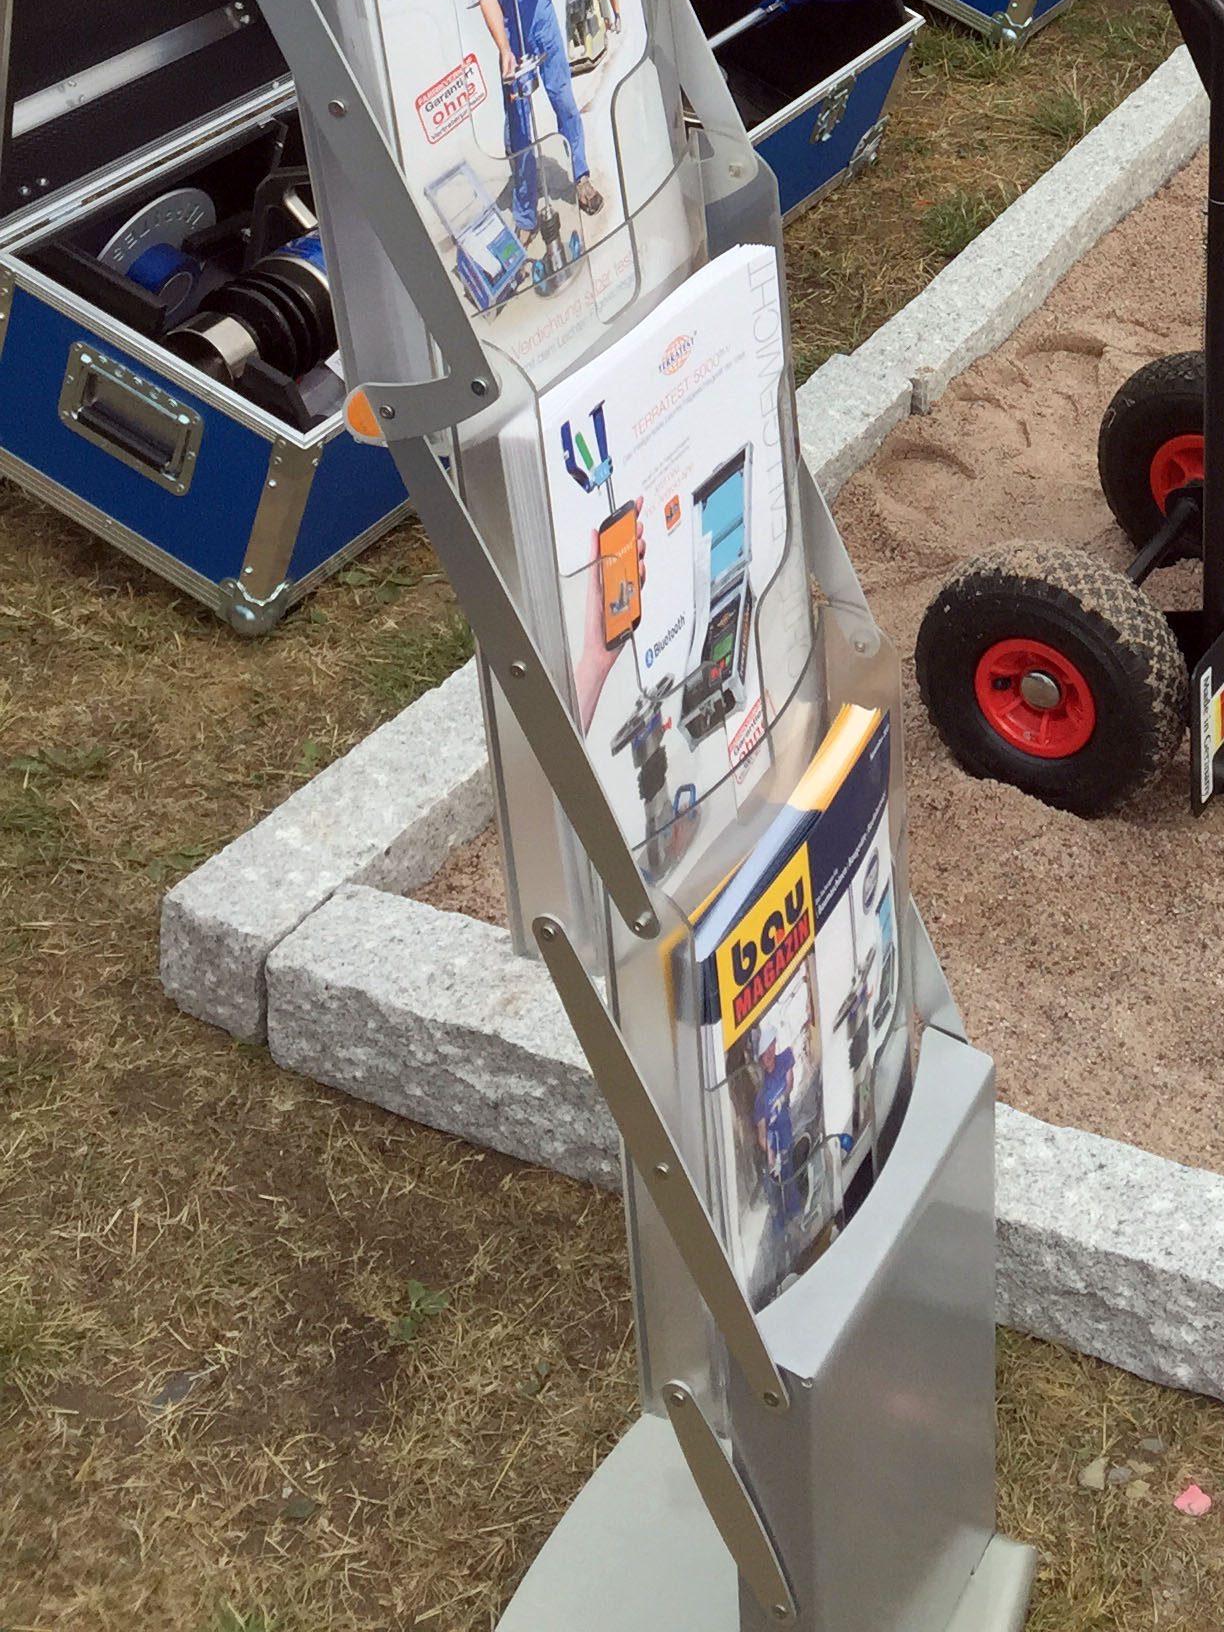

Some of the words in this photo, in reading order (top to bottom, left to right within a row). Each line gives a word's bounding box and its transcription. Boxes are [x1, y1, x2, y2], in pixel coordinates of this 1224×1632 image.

[658, 337, 695, 373] TERRATEST
[632, 378, 691, 439] TERRATEST
[653, 611, 687, 658] Bluetooth
[1203, 677, 1211, 714] Made
[1203, 735, 1212, 797] Germany
[731, 877, 804, 987] bau
[734, 911, 810, 1025] MAGAZIN
